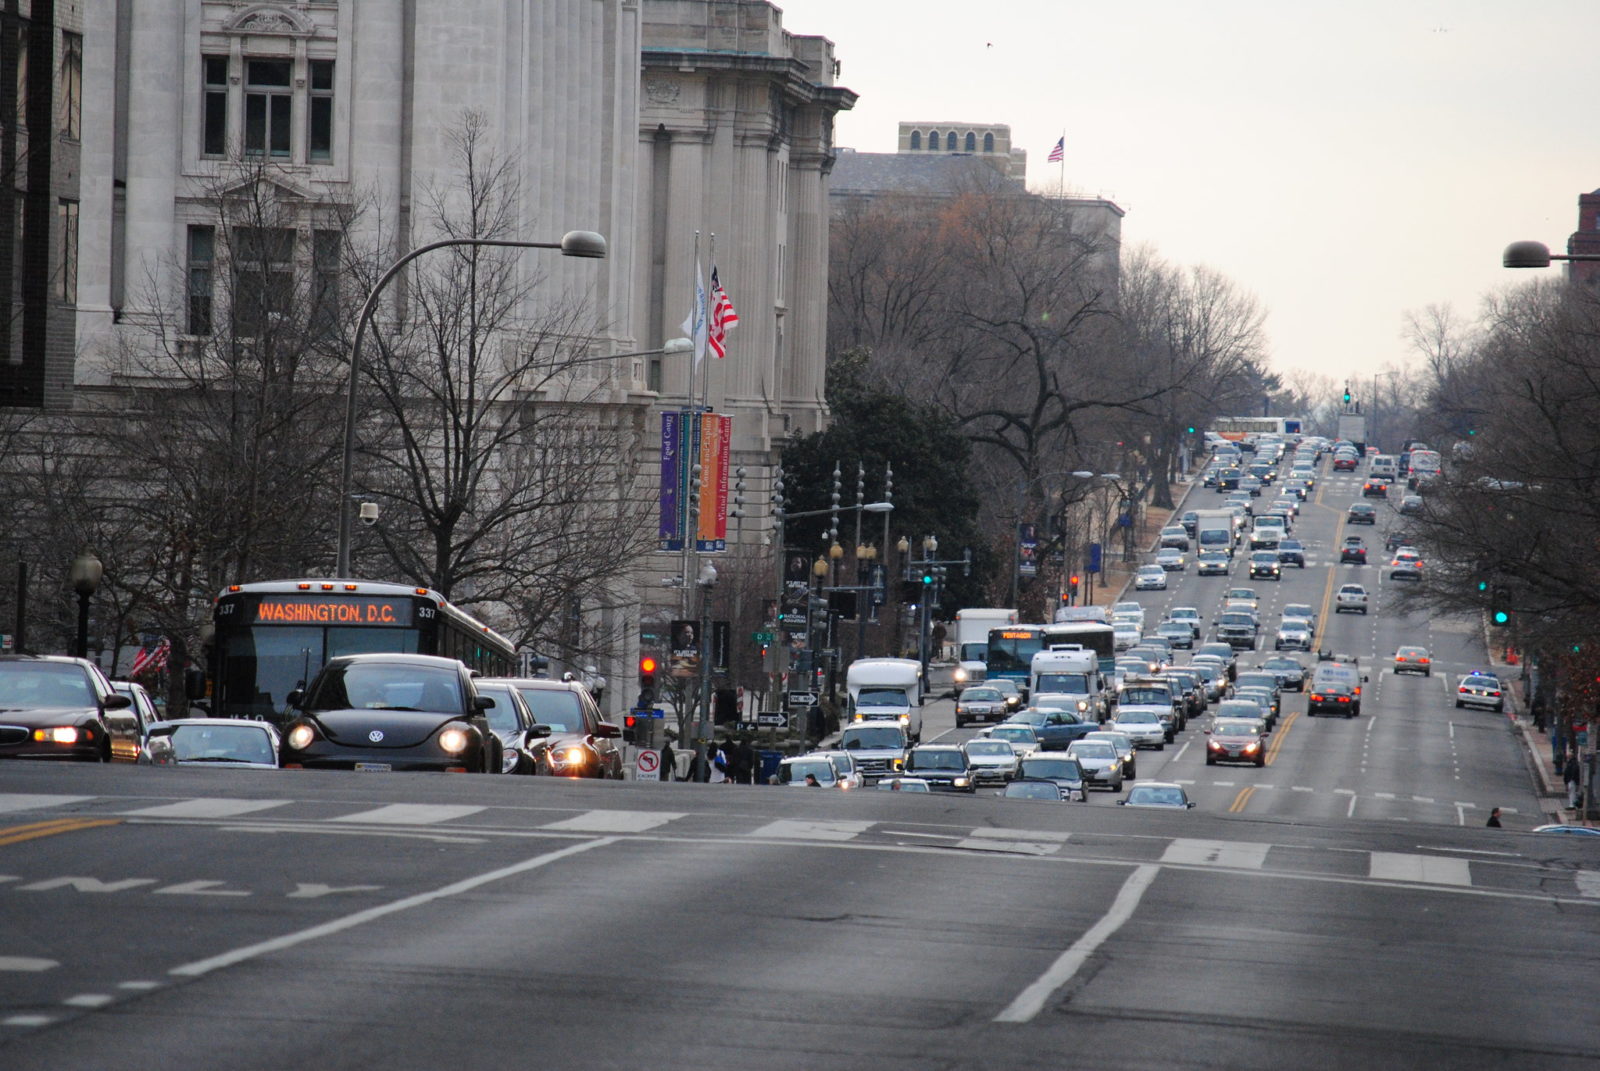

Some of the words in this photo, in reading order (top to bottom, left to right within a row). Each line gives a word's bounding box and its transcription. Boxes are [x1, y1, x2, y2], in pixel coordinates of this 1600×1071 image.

[722, 417, 730, 443] Center
[663, 441, 671, 460] Food
[701, 464, 710, 488] Come
[719, 445, 729, 492] Information
[718, 495, 726, 521] Visitor
[219, 604, 234, 615] 337
[367, 604, 396, 622] D.C.
[419, 607, 436, 619] 337
